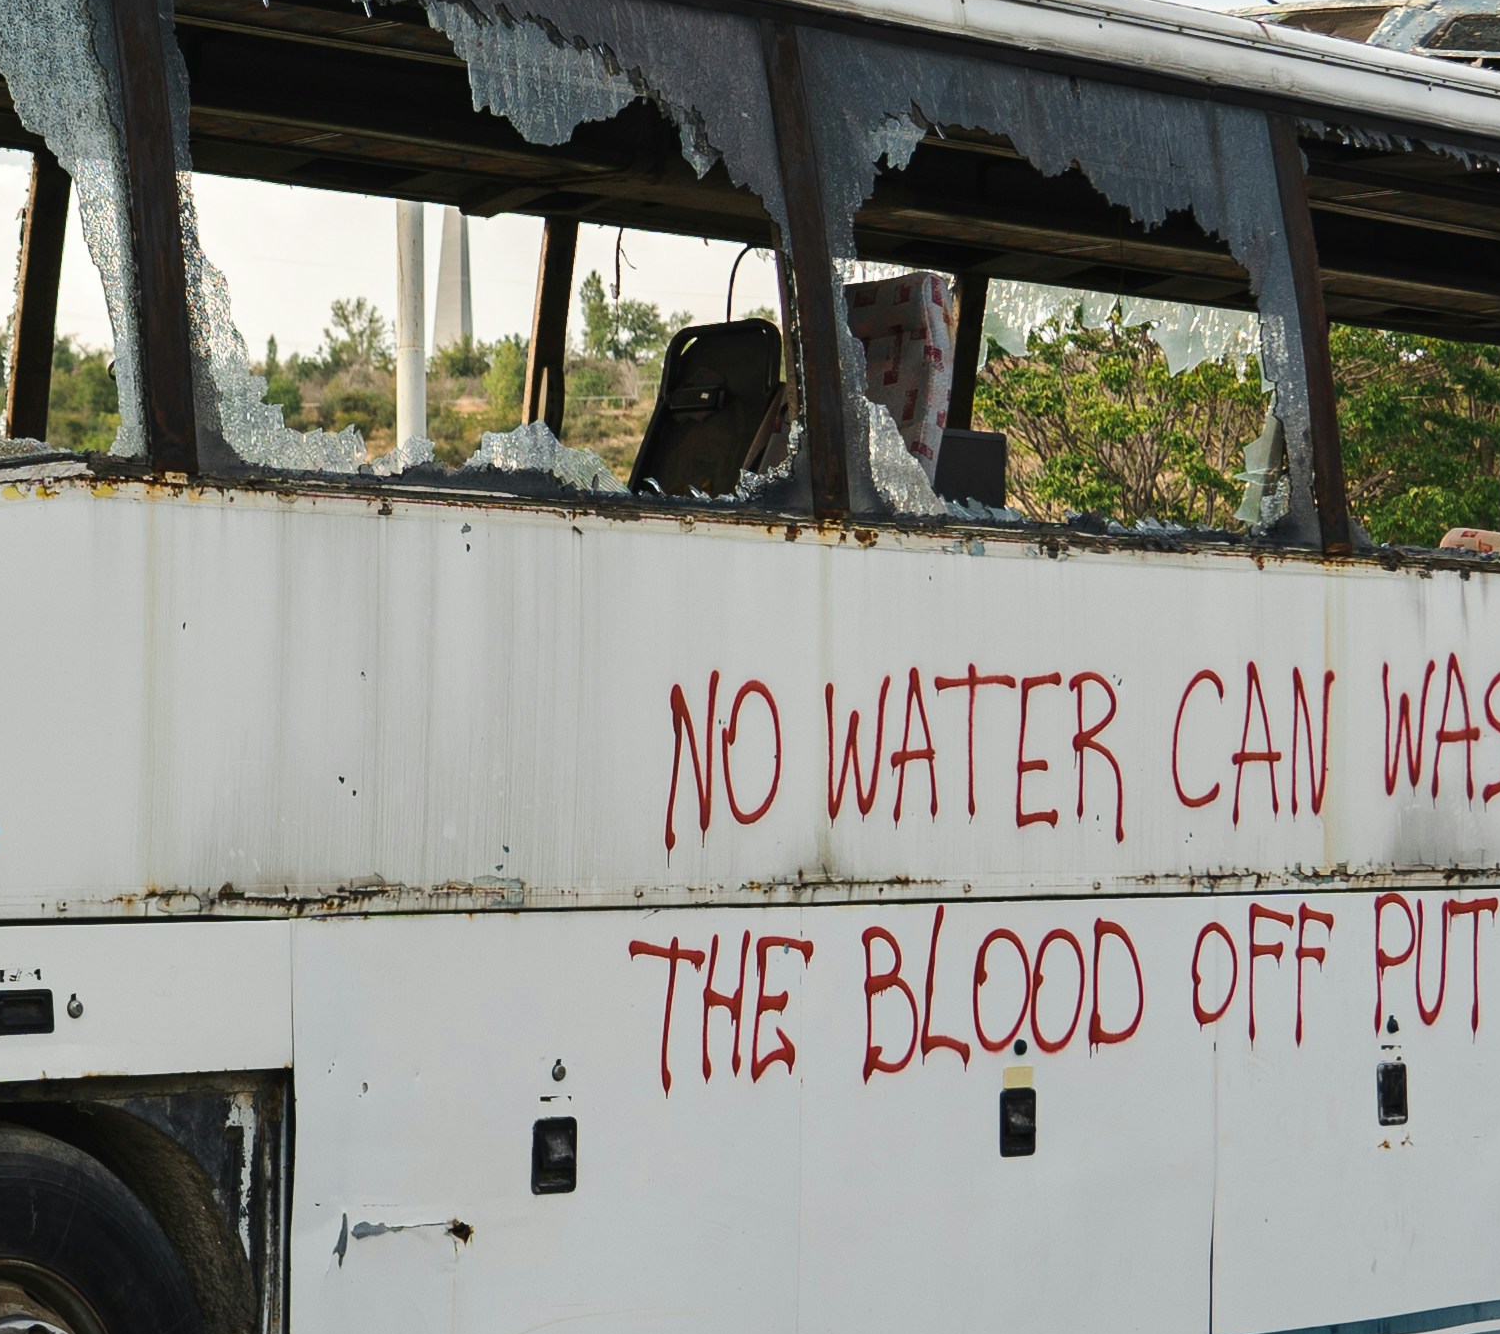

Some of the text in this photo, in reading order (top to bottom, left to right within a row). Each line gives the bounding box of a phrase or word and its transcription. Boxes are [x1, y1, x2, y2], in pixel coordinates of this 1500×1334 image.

[665, 669, 783, 850] NO
[824, 663, 1125, 843] WATER
[1172, 661, 1336, 825] CAN
[628, 930, 815, 1094] THE
[862, 904, 1145, 1082] BLOOD
[1192, 902, 1335, 1045] OFF
